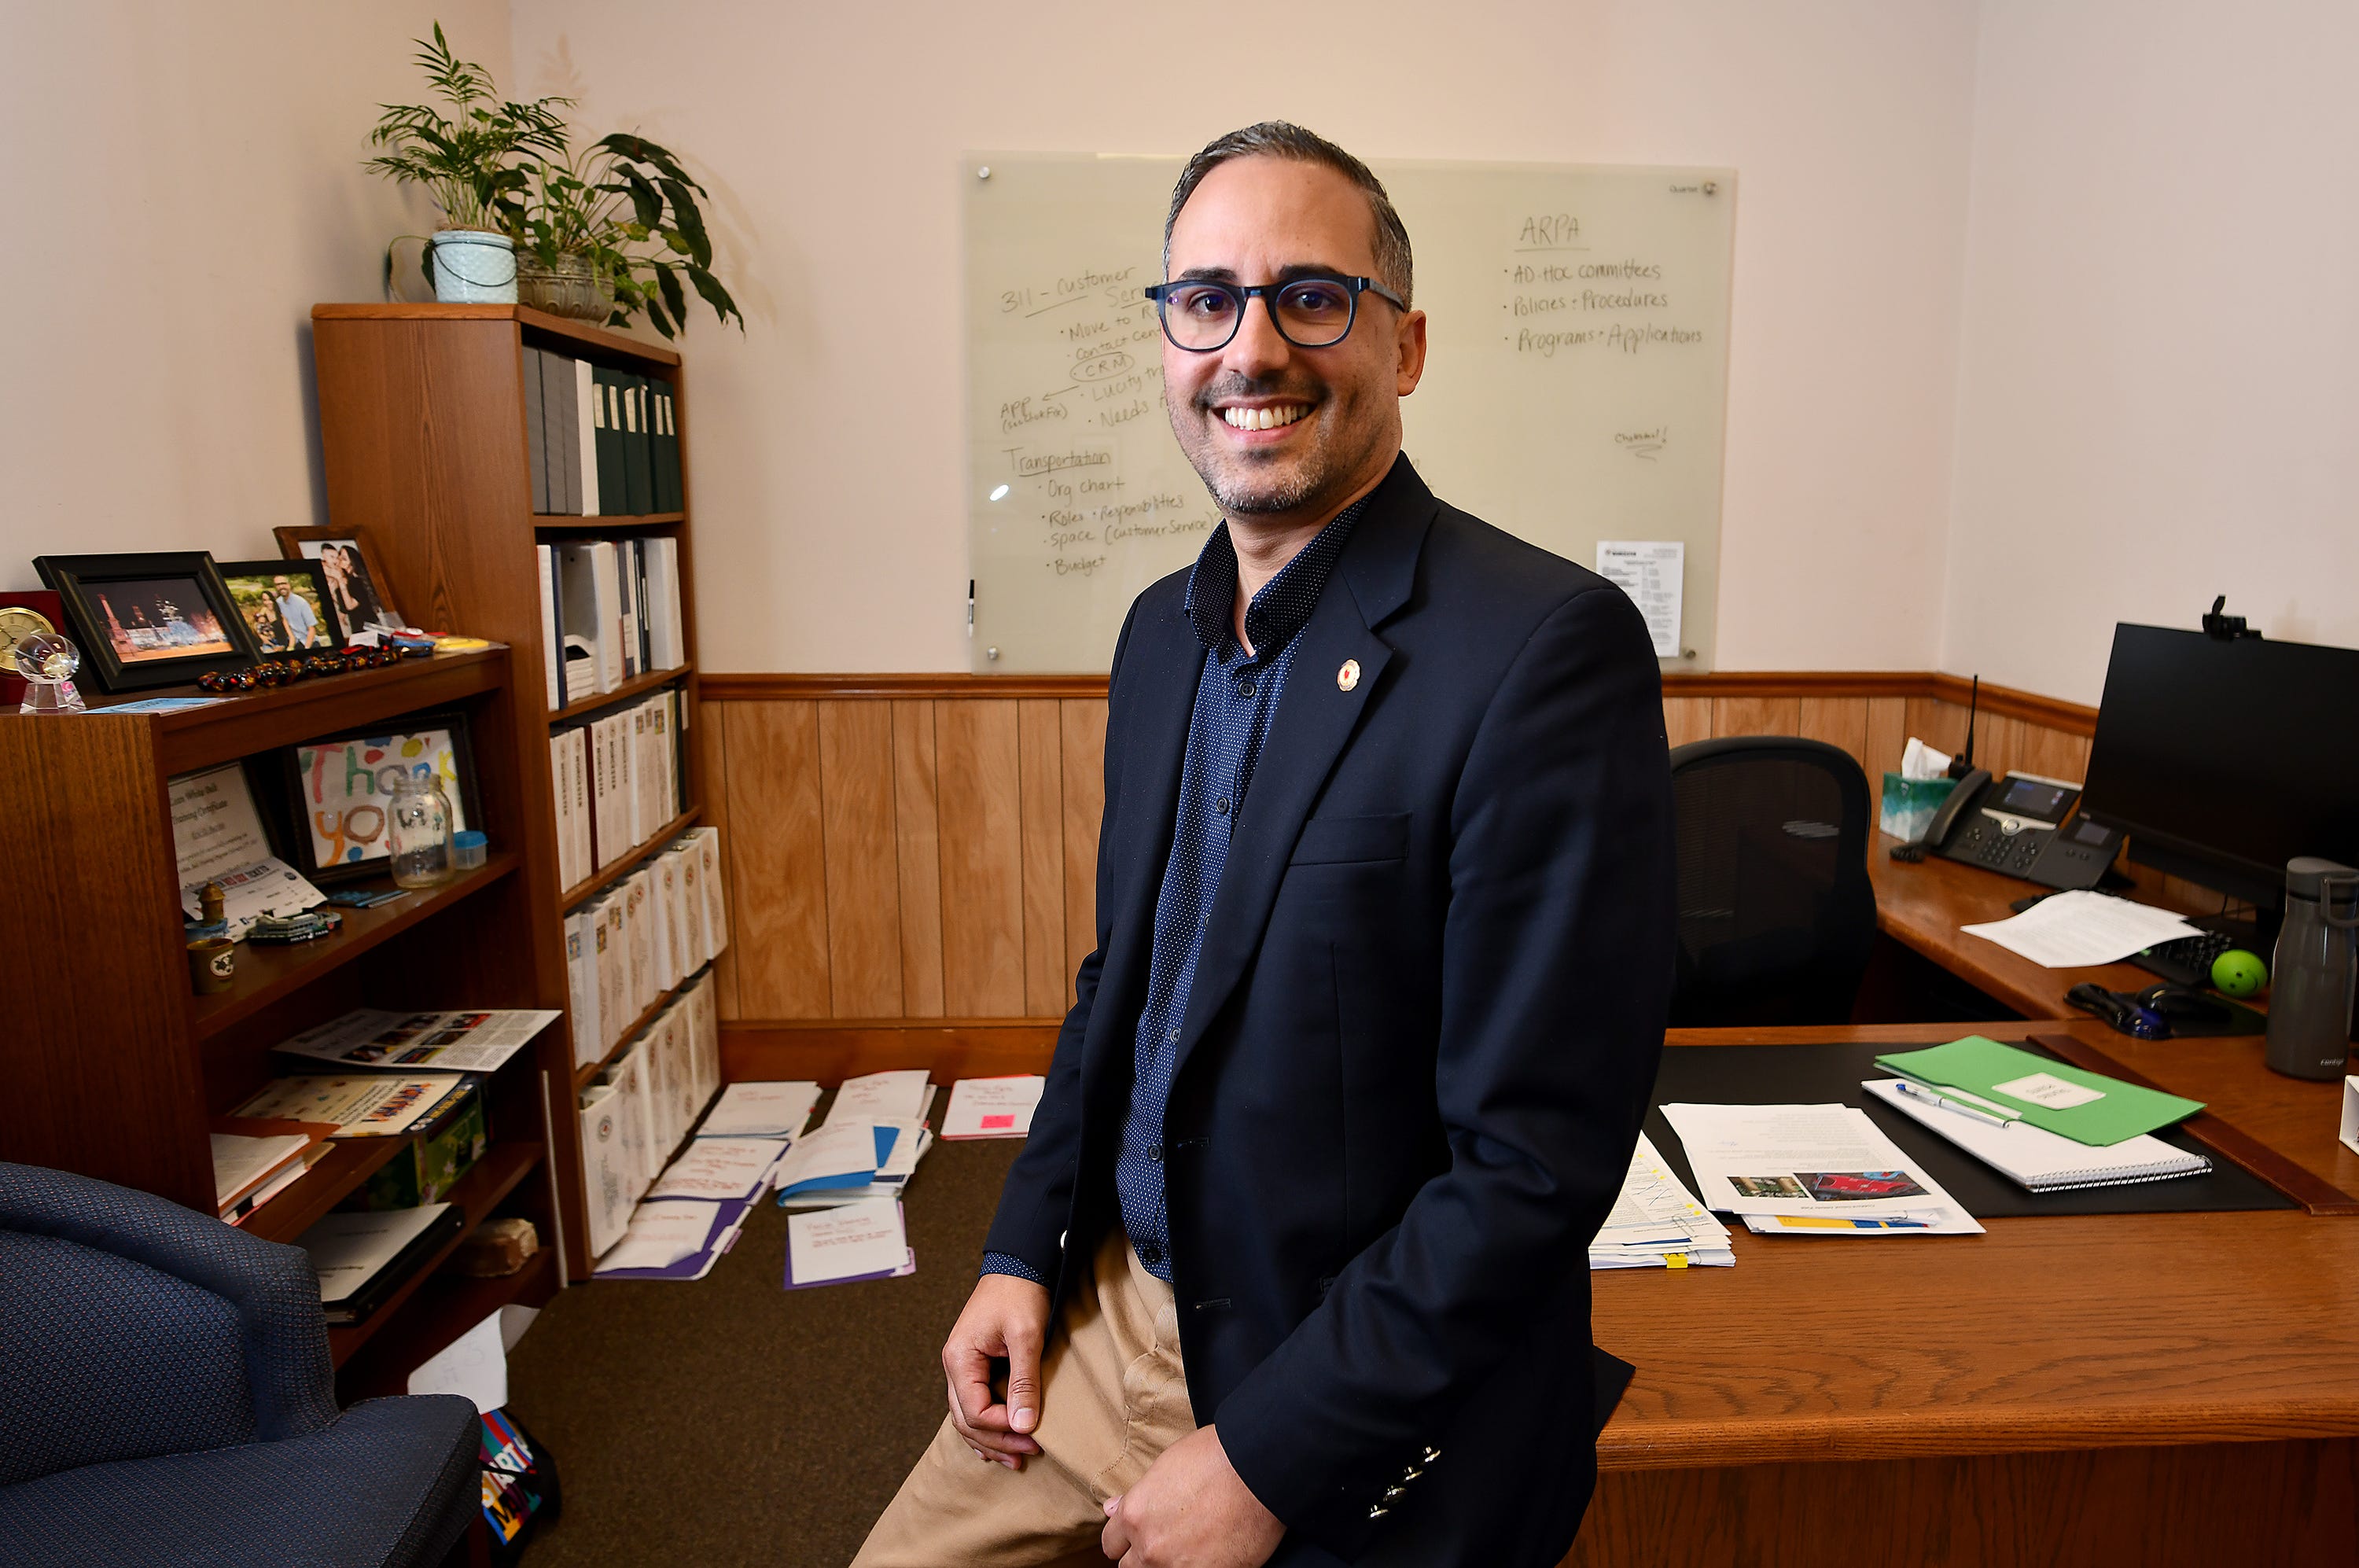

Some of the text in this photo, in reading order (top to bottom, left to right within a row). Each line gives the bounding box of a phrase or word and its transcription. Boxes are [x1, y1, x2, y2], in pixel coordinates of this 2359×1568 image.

[1519, 213, 1581, 247] ARPA
[1000, 289, 1032, 313] 311
[1057, 266, 1138, 296] Customer
[1514, 288, 1669, 316] Policies Procedures
[1069, 323, 1109, 341] Move
[1115, 315, 1131, 326] to
[1518, 322, 1702, 358] Programs Applications
[1085, 355, 1128, 377] CRM
[1002, 447, 1112, 473] Transportation
[1047, 480, 1072, 506] Org
[1049, 510, 1084, 528] Roles
[1055, 556, 1106, 576] Budget
